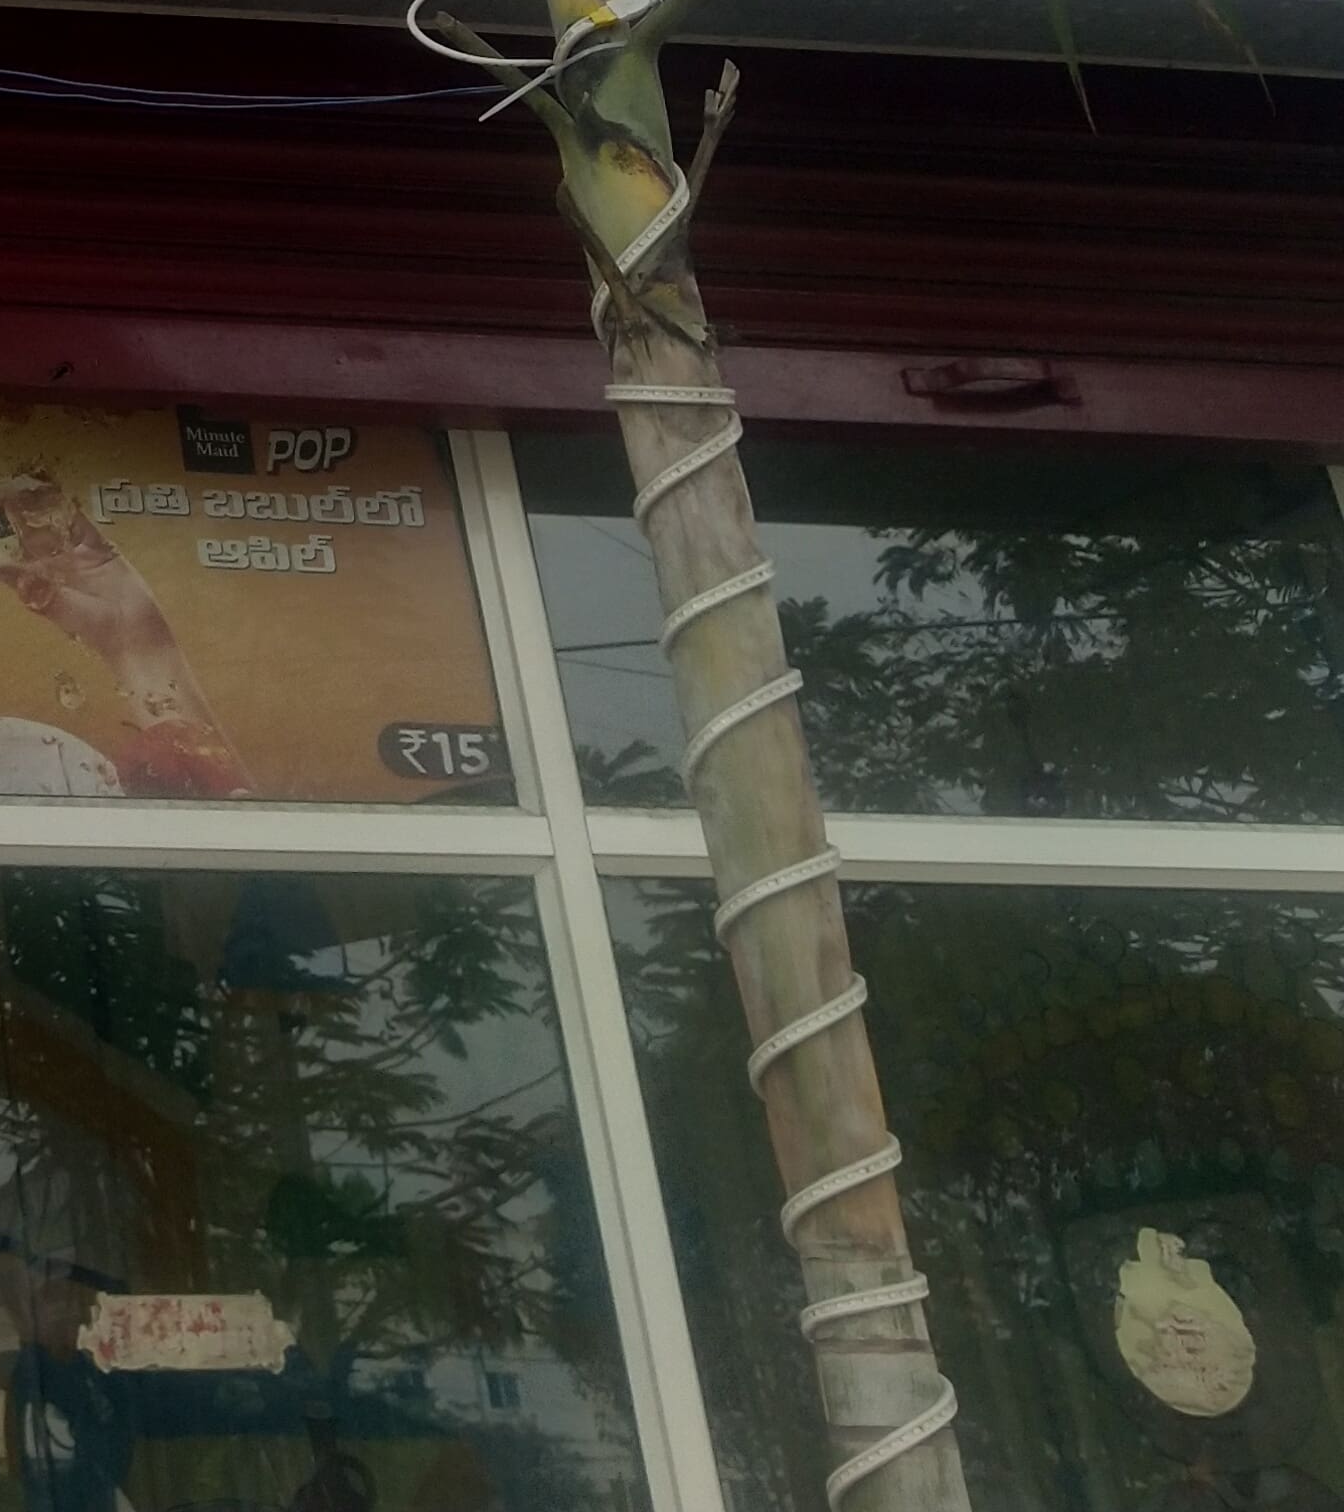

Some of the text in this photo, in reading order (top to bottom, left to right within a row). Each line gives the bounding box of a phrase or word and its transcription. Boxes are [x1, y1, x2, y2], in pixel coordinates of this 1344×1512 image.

[185, 426, 246, 445] Minute
[195, 441, 241, 459] Maid
[266, 426, 352, 473] POP
